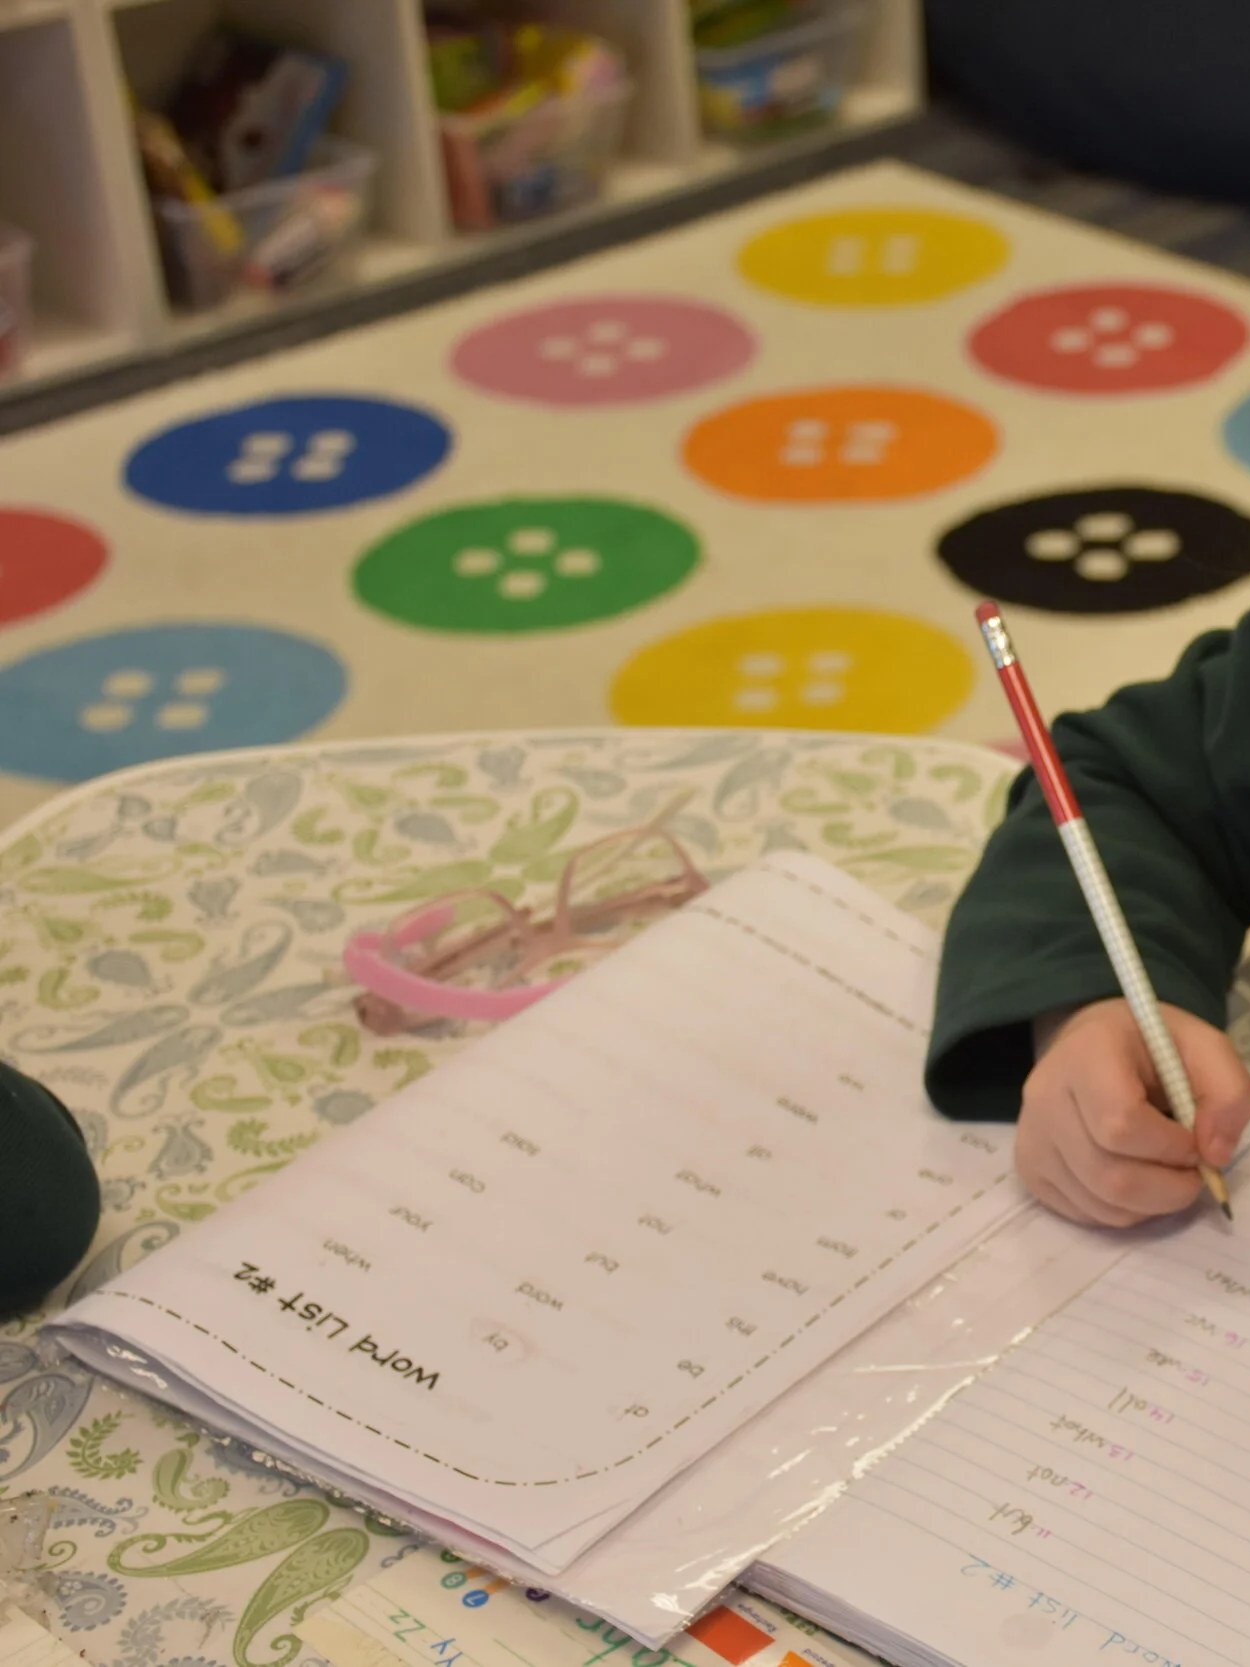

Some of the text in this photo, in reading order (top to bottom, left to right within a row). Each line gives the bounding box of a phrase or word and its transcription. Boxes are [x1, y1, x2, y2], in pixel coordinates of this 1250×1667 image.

[449, 1169, 486, 1193] can
[388, 1206, 433, 1233] your
[323, 1239, 371, 1272] when
[584, 1250, 620, 1274] but
[761, 1270, 811, 1296] have
[515, 1281, 563, 1311] word
[233, 1262, 440, 1390] Word List #2
[725, 1316, 760, 1337] this
[482, 1331, 509, 1354] by
[677, 1359, 705, 1379] be
[624, 1403, 649, 1418] at
[1107, 1386, 1148, 1414] all
[1027, 1464, 1069, 1488] not
[1027, 1591, 1078, 1630] list
